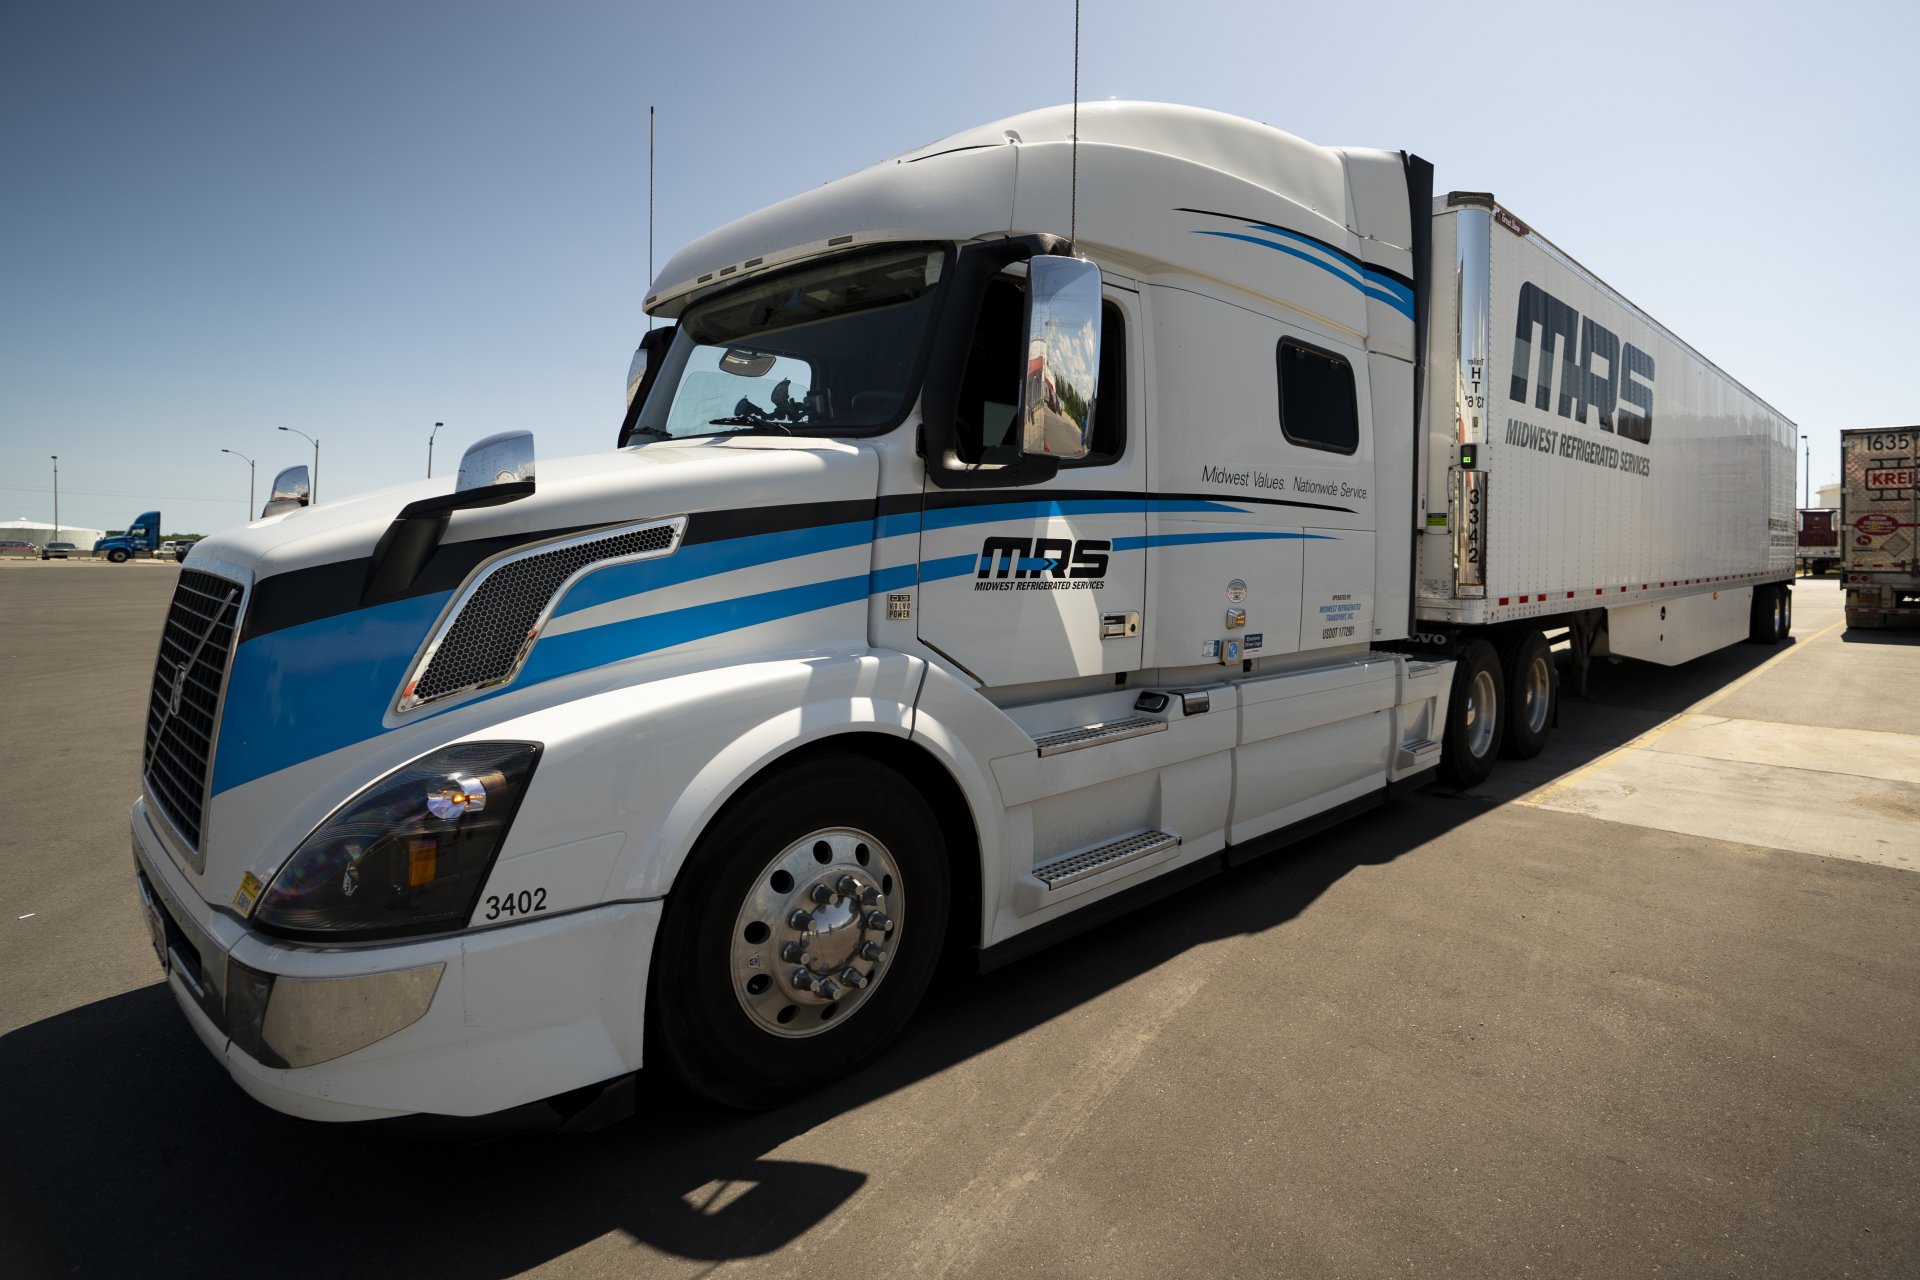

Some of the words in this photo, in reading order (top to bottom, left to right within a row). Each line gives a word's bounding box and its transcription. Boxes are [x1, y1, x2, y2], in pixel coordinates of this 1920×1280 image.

[1509, 280, 1655, 445] MRS
[1505, 418, 1559, 455] MIDWEST
[1559, 433, 1619, 469] REFRIGERATED
[1619, 450, 1651, 477] SERVICES
[1866, 433, 1909, 451] 1635
[1201, 464, 1250, 487] Midwest
[1293, 476, 1338, 496] Nationwide
[978, 536, 1111, 579] MRS
[974, 581, 1015, 591] MIDWEST
[1016, 581, 1071, 591] REFRIGERATED
[1071, 580, 1105, 590] SERVICES
[889, 602, 910, 610] VOLVO
[889, 609, 910, 618] POWER
[1322, 627, 1338, 640] USDOT
[485, 887, 547, 920] 3402
